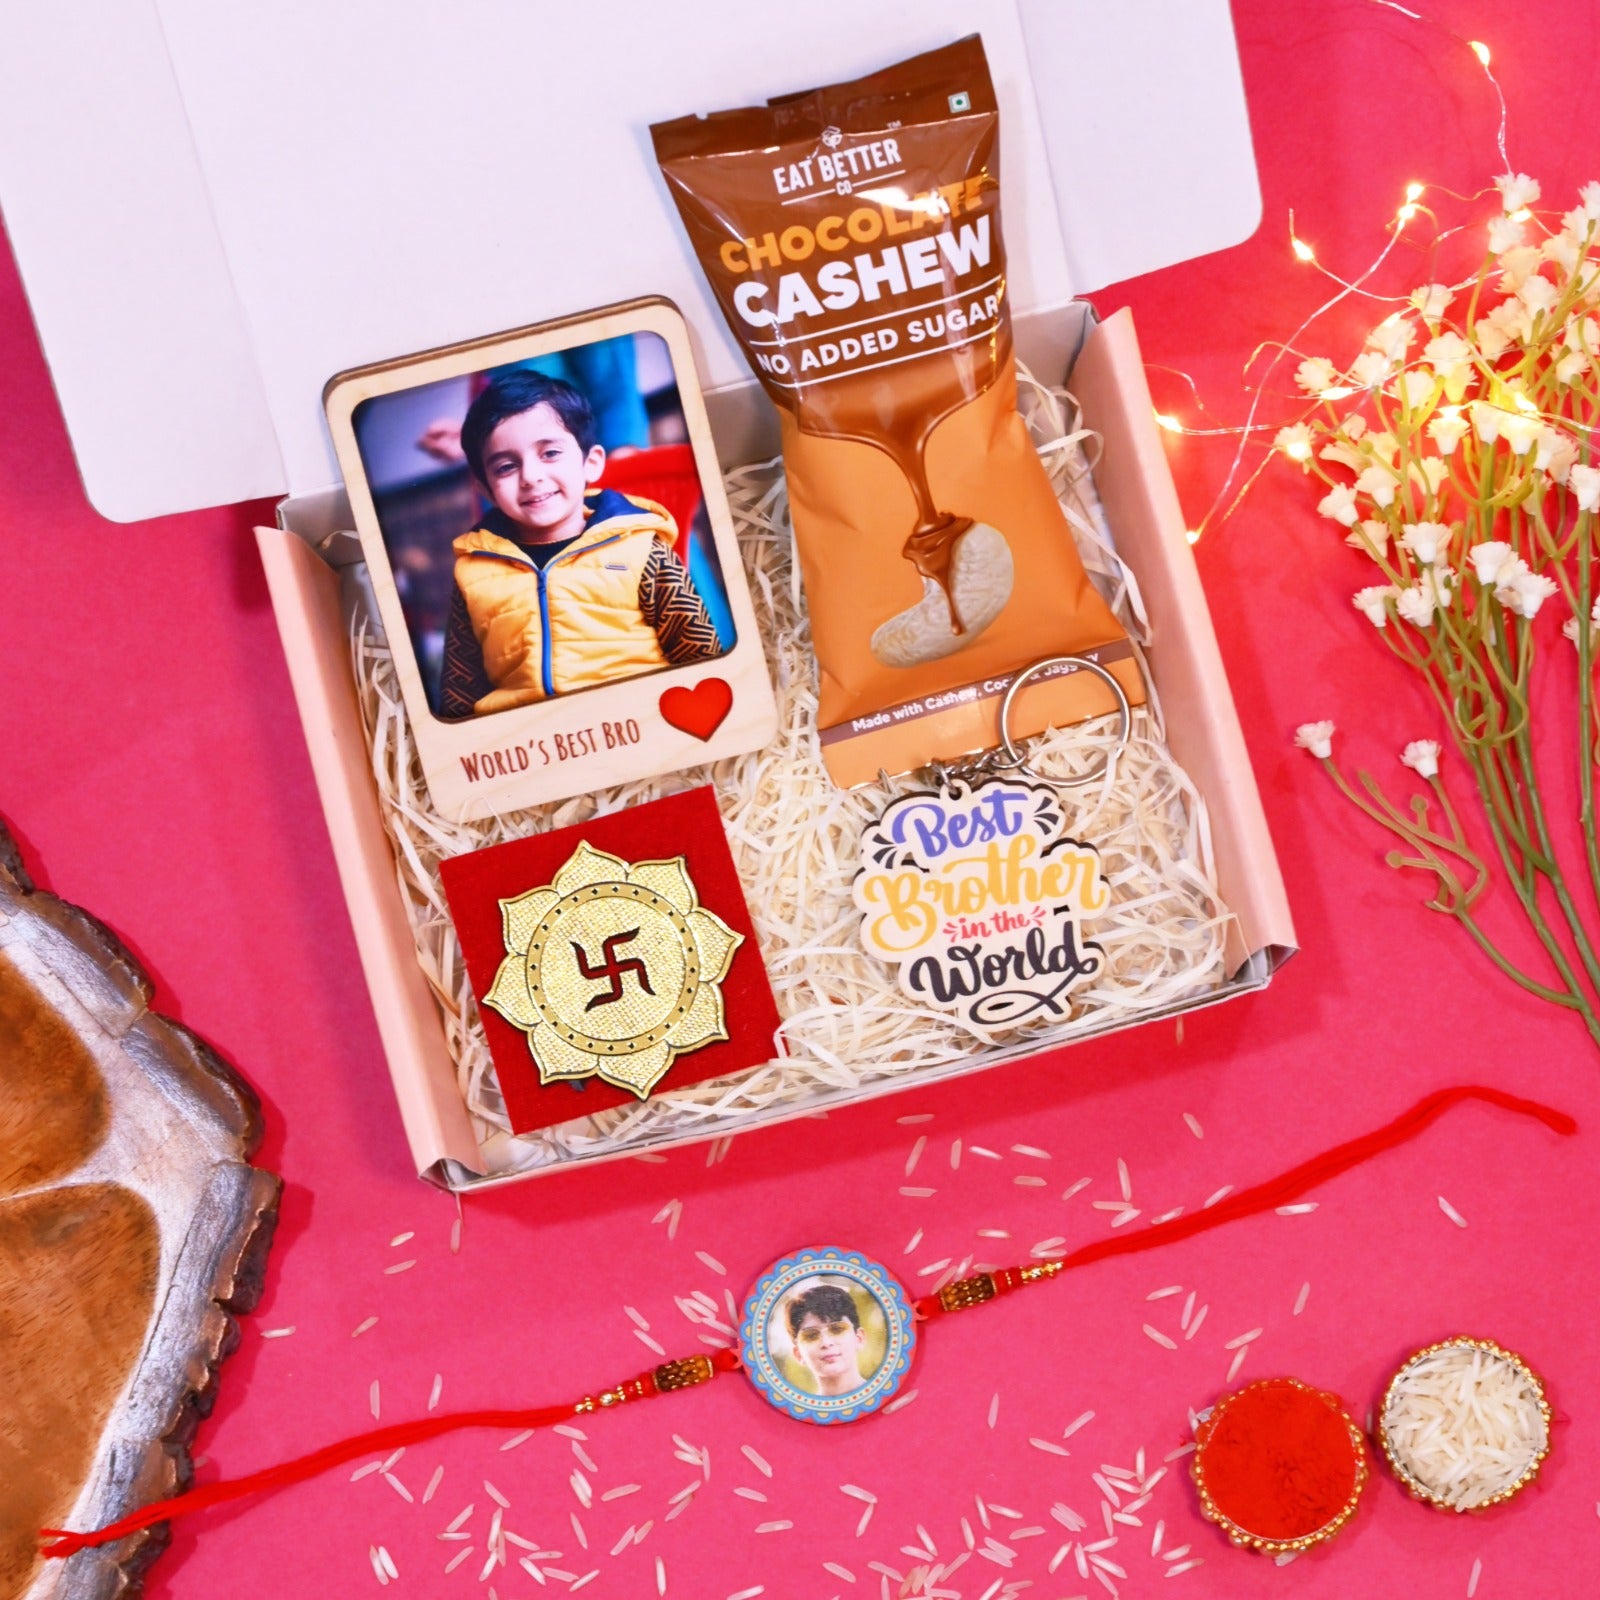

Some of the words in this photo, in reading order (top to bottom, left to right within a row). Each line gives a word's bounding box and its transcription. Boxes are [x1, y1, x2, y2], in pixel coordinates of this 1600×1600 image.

[773, 158, 814, 194] EAT
[821, 138, 901, 182] BETTER
[836, 180, 852, 196] CO
[733, 214, 991, 328] CASHEW
[756, 353, 790, 375] NO
[801, 328, 899, 371] ADDED
[909, 295, 998, 343] SUGAR
[852, 713, 891, 732] Made
[893, 703, 924, 721] with
[892, 789, 1028, 858] Best
[863, 834, 1106, 952] Brother
[958, 917, 992, 940] in
[990, 911, 1031, 934] the
[909, 920, 1099, 1025] World
